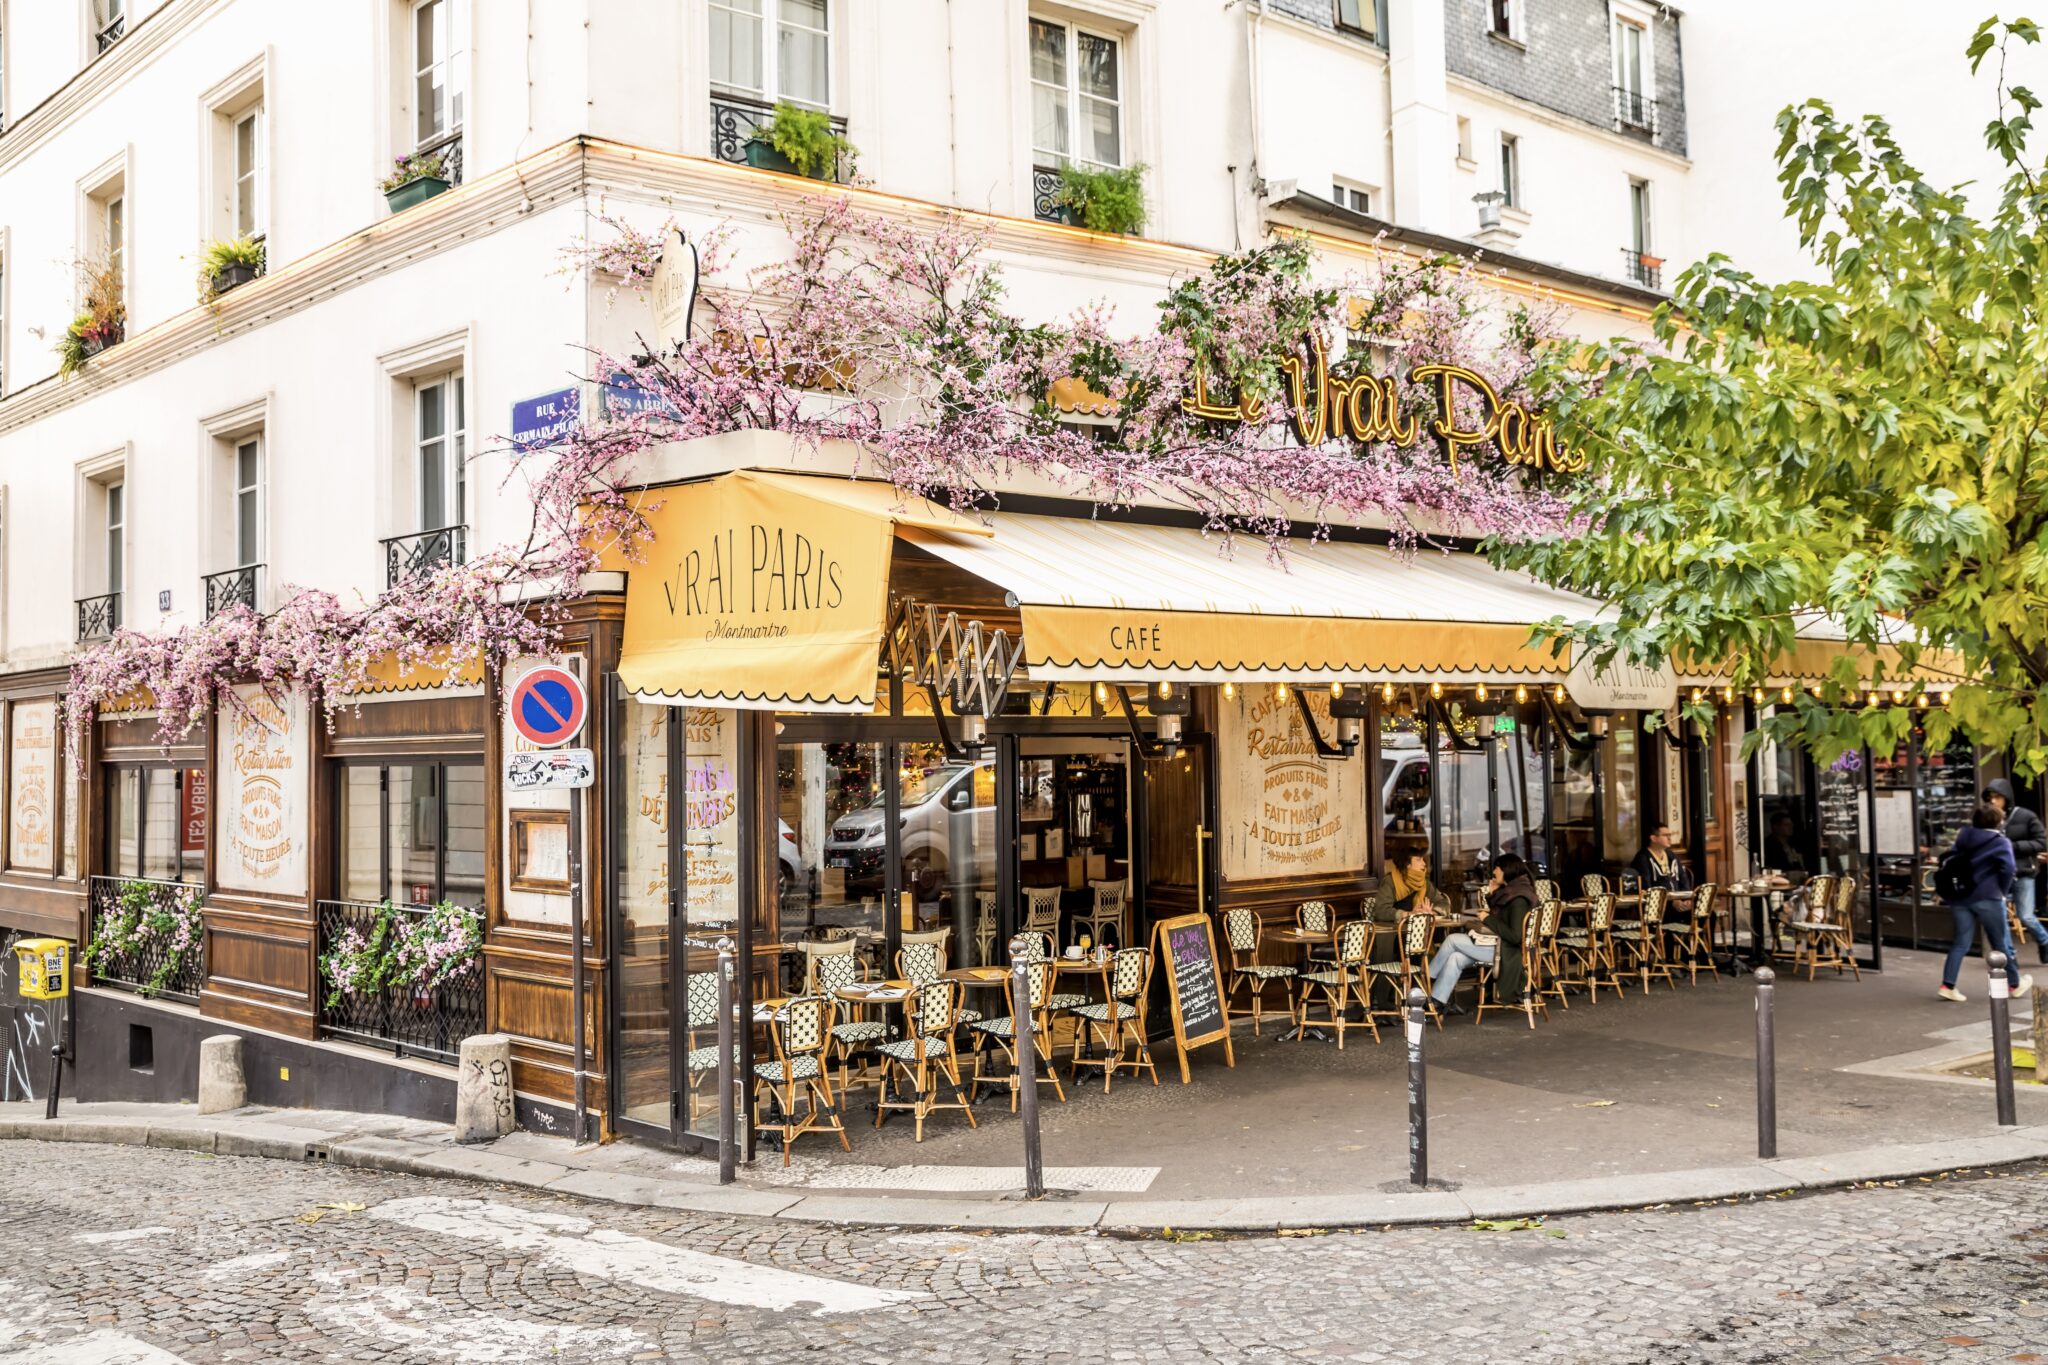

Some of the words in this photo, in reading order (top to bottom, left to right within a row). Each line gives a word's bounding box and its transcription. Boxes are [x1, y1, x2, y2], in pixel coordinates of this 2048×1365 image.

[1279, 325, 1418, 448] Vrai
[536, 402, 555, 418] RUE
[513, 425, 551, 443] GERMAIN
[664, 528, 734, 616] VRAI
[751, 525, 843, 613] PARIS
[160, 591, 170, 609] 33
[706, 618, 790, 642] Montmartre
[1111, 623, 1161, 651] CAFÉ
[234, 743, 293, 776] Restauration
[514, 771, 538, 788] RICKS
[1264, 769, 1304, 793] PRODUITS
[1305, 771, 1329, 791] FRAIS
[242, 785, 267, 810] PRODUITS
[267, 787, 282, 810] FRAIS
[1293, 788, 1300, 803] &
[1264, 801, 1288, 825] FAIT
[1290, 801, 1328, 825] MAISON
[240, 813, 254, 834] FAIT
[255, 815, 282, 841] MAISON
[1262, 826, 1302, 847] TOUTE
[1304, 815, 1342, 845] HEURE
[238, 839, 265, 863] TOUTE
[265, 837, 292, 862] HEURE
[48, 958, 62, 967] BNE
